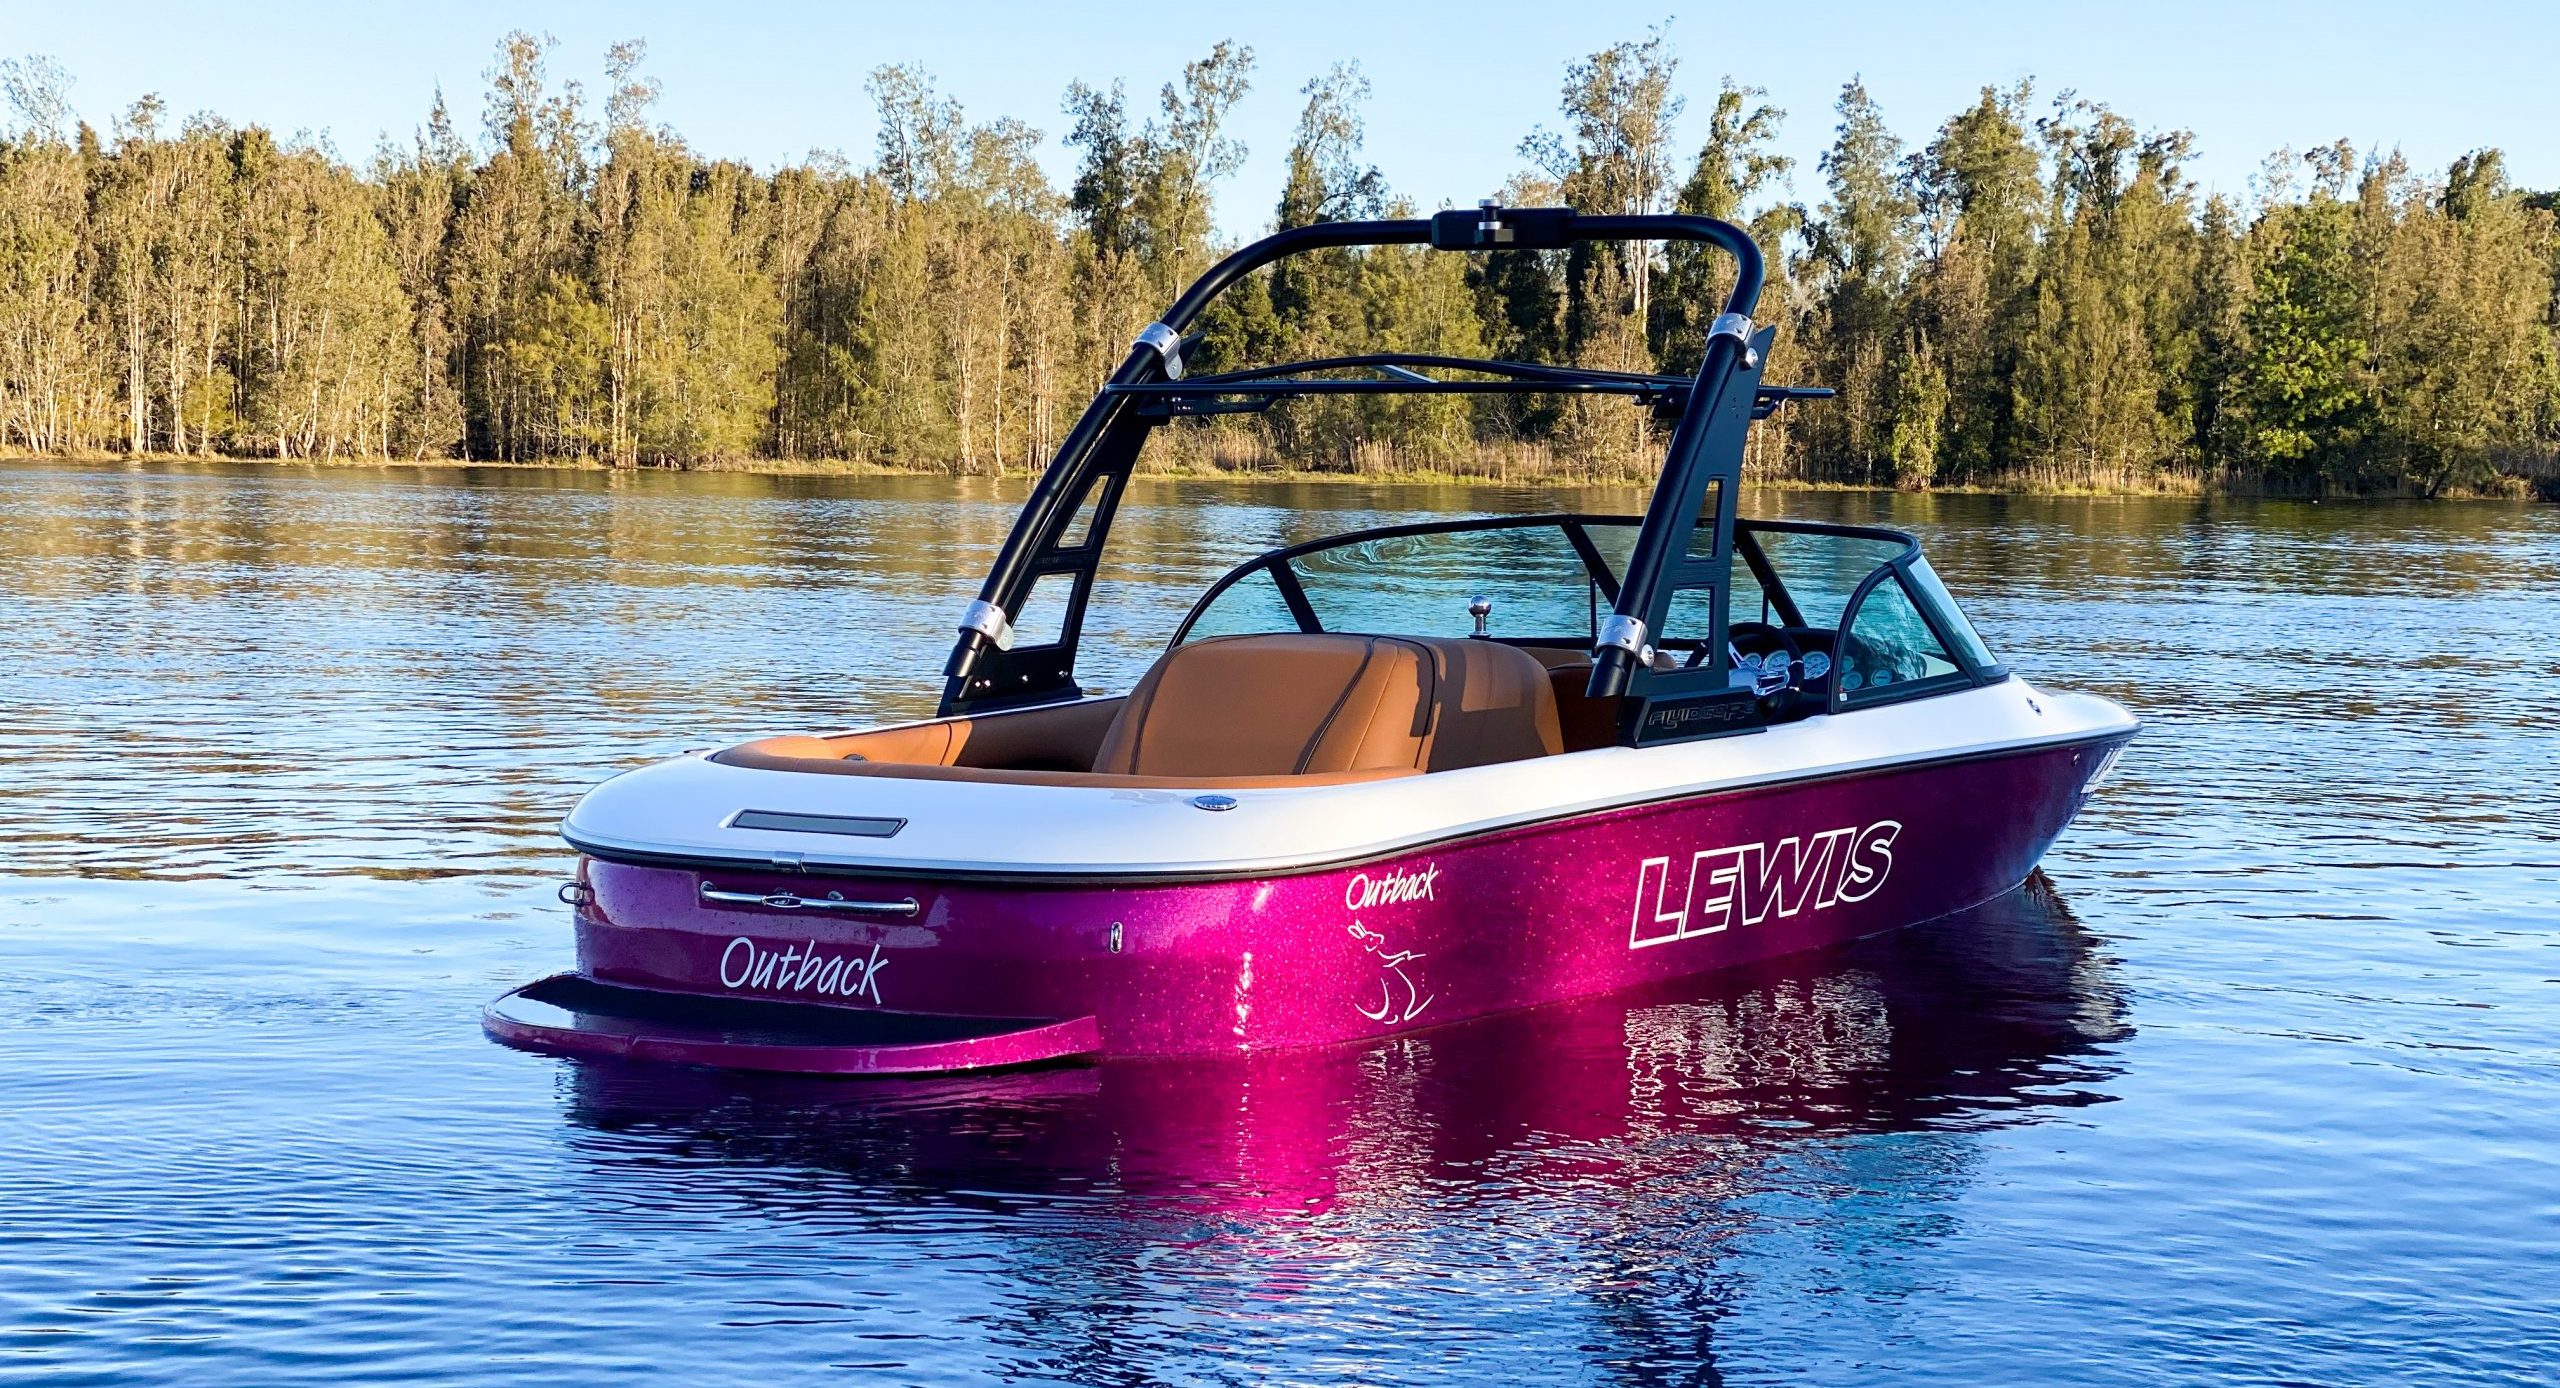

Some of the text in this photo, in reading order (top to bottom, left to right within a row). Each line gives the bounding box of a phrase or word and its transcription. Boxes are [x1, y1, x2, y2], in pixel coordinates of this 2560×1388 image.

[1346, 862, 1439, 910] Outback
[1629, 820, 1902, 949] LEWIS
[720, 937, 889, 1004] Outback
